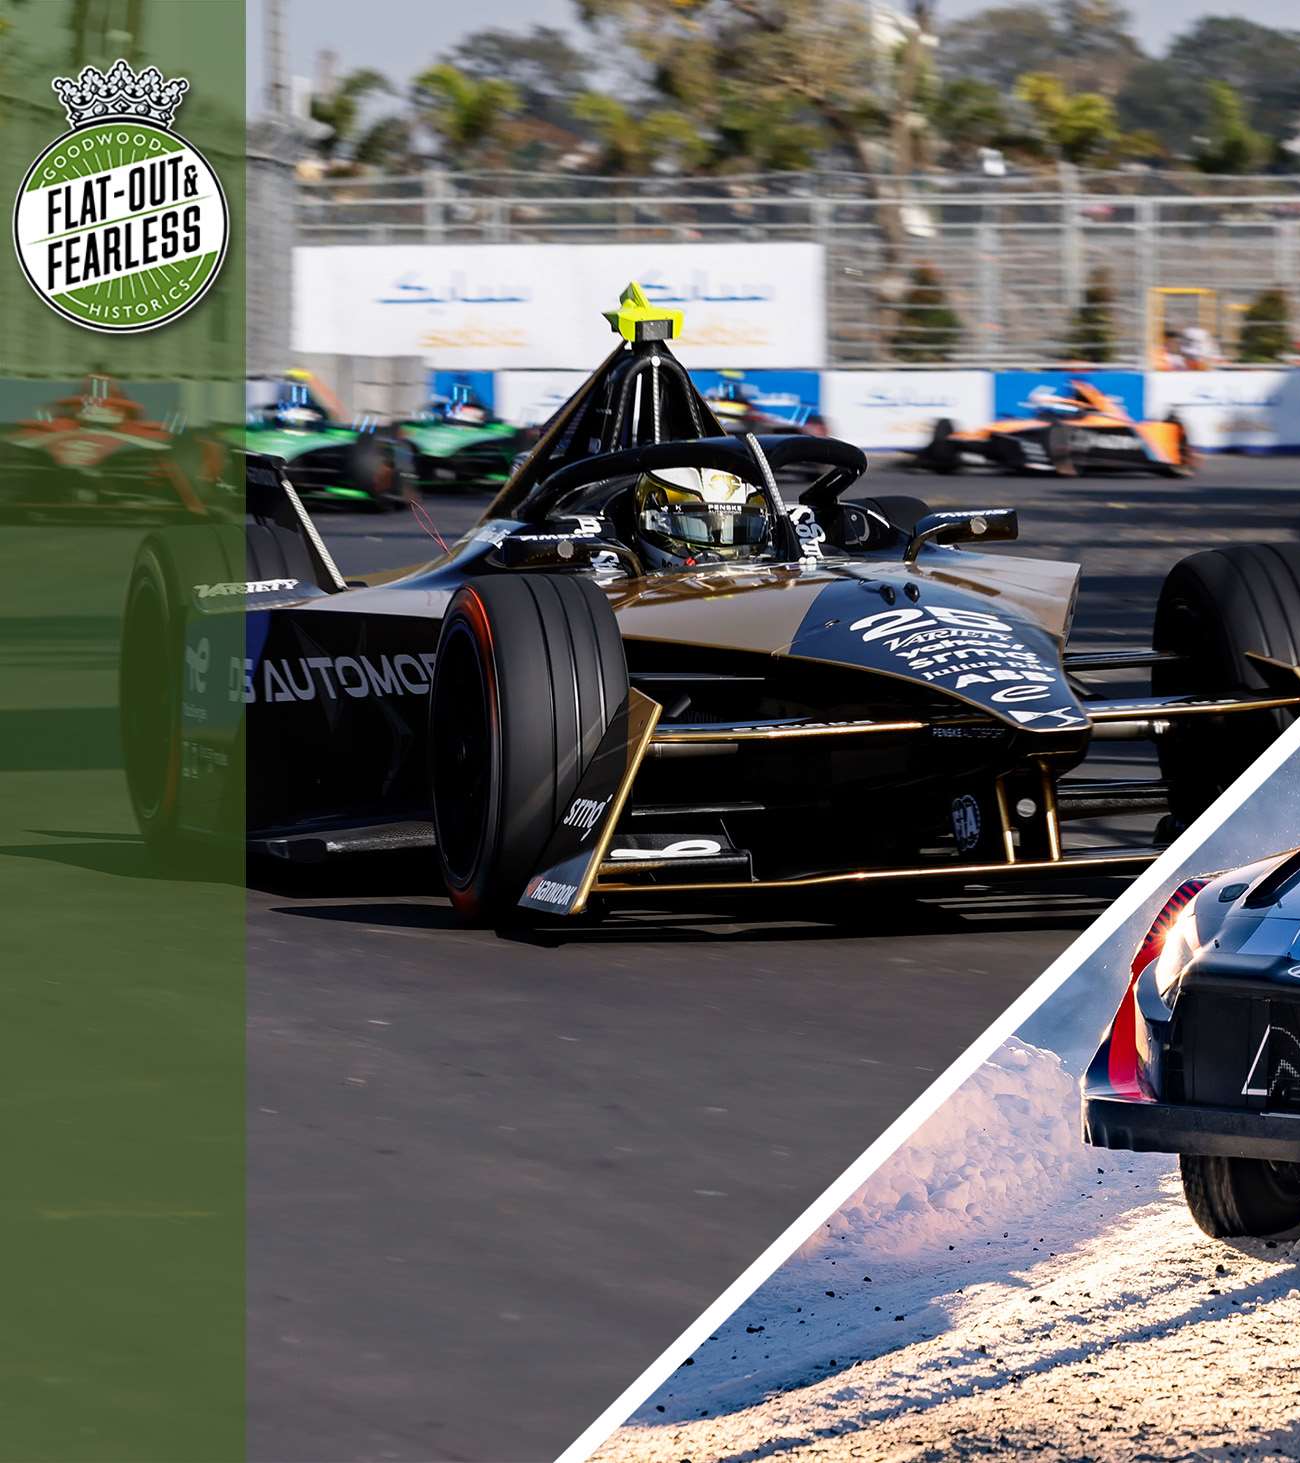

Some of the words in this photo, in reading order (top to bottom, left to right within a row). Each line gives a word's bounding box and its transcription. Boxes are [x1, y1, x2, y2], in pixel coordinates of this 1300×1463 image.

[193, 579, 300, 598] VARIETY
[850, 606, 1013, 642] 25
[882, 629, 1014, 652] VARIETY
[896, 638, 1025, 660] yahoo!
[920, 661, 1002, 681] Julius
[955, 669, 1058, 689] ABB
